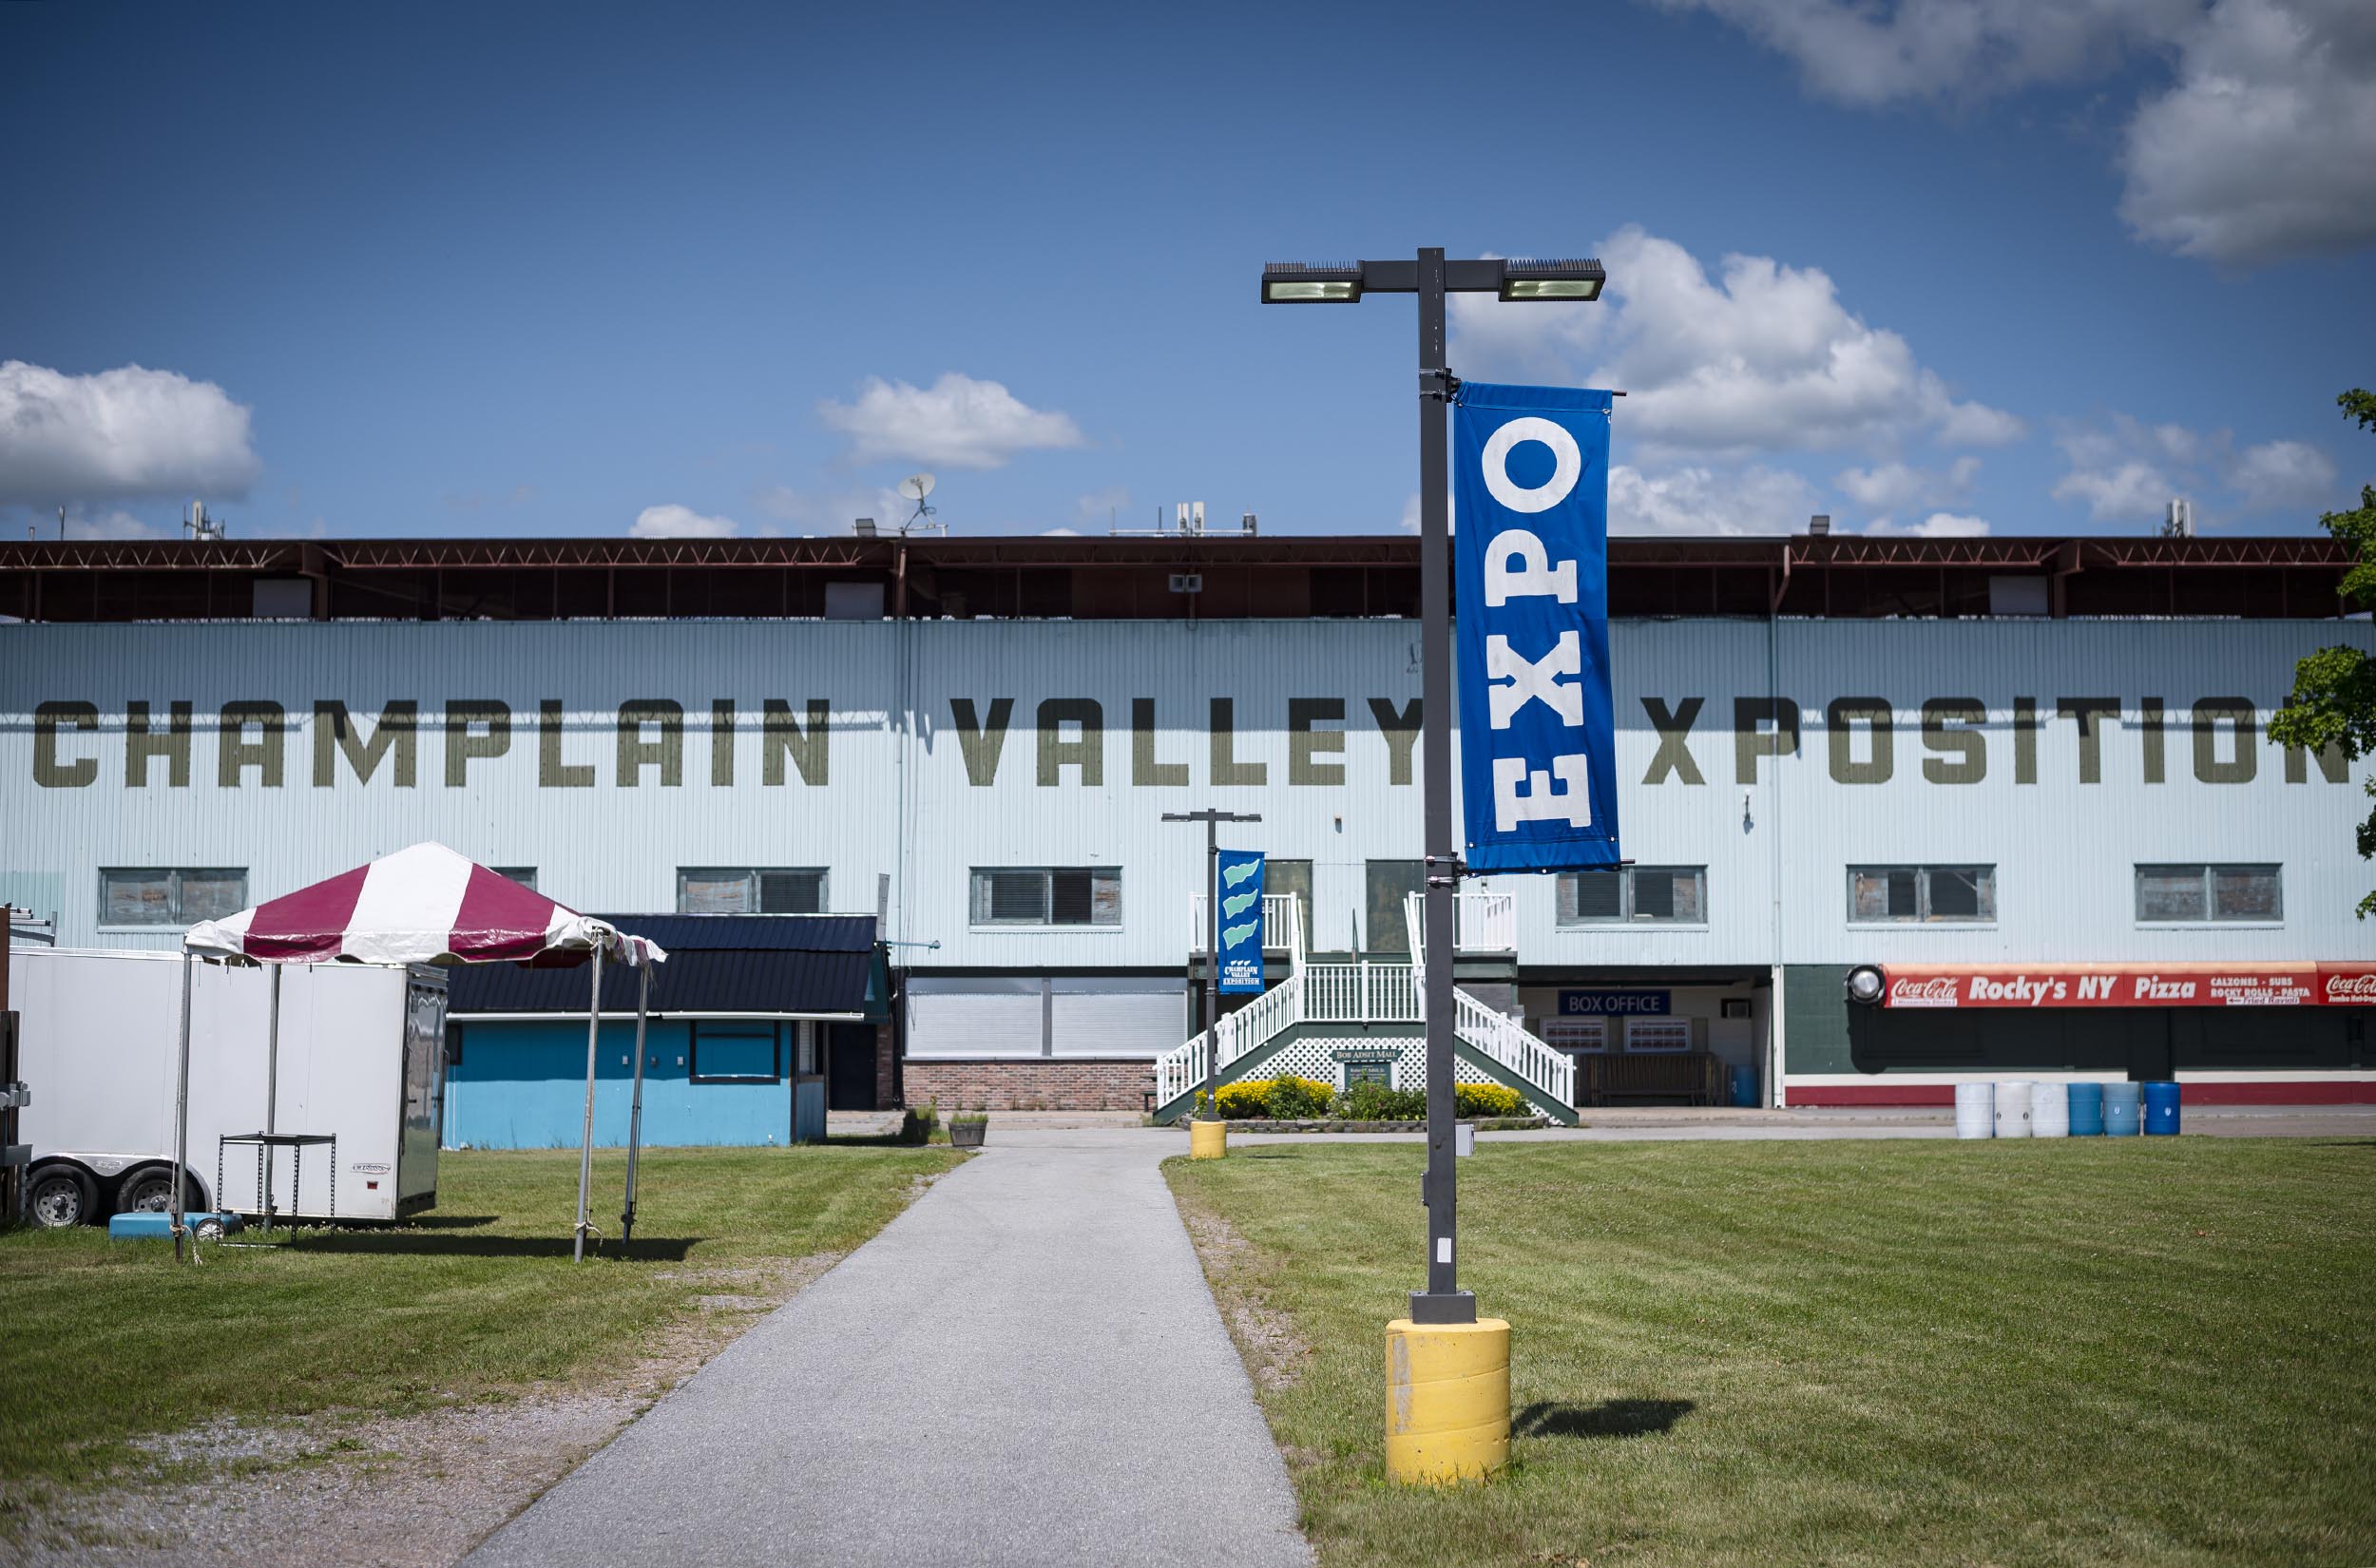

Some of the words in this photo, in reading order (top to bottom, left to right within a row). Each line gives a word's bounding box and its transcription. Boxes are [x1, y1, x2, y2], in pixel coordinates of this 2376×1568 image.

[1481, 416, 1591, 832] EXPO
[32, 698, 831, 788] CHAMPLAIN
[950, 697, 1424, 787] VALLEY
[1224, 966, 1258, 975] CHAMPLAIN
[1222, 977, 1260, 985] EXPOSITION
[1890, 977, 1959, 999] Coca-Cola
[2210, 977, 2258, 987] CALZONES
[2269, 977, 2293, 986] SUBS
[1968, 975, 2066, 1006] Rocky's
[2076, 976, 2117, 1000] NY
[2135, 975, 2196, 1000] Pizza
[2210, 987, 2242, 998] ROCKY
[2244, 987, 2273, 998] ROLLS
[2281, 986, 2310, 997] PASTA
[1568, 995, 1602, 1012] BOX
[1605, 995, 1661, 1012] OFFICE
